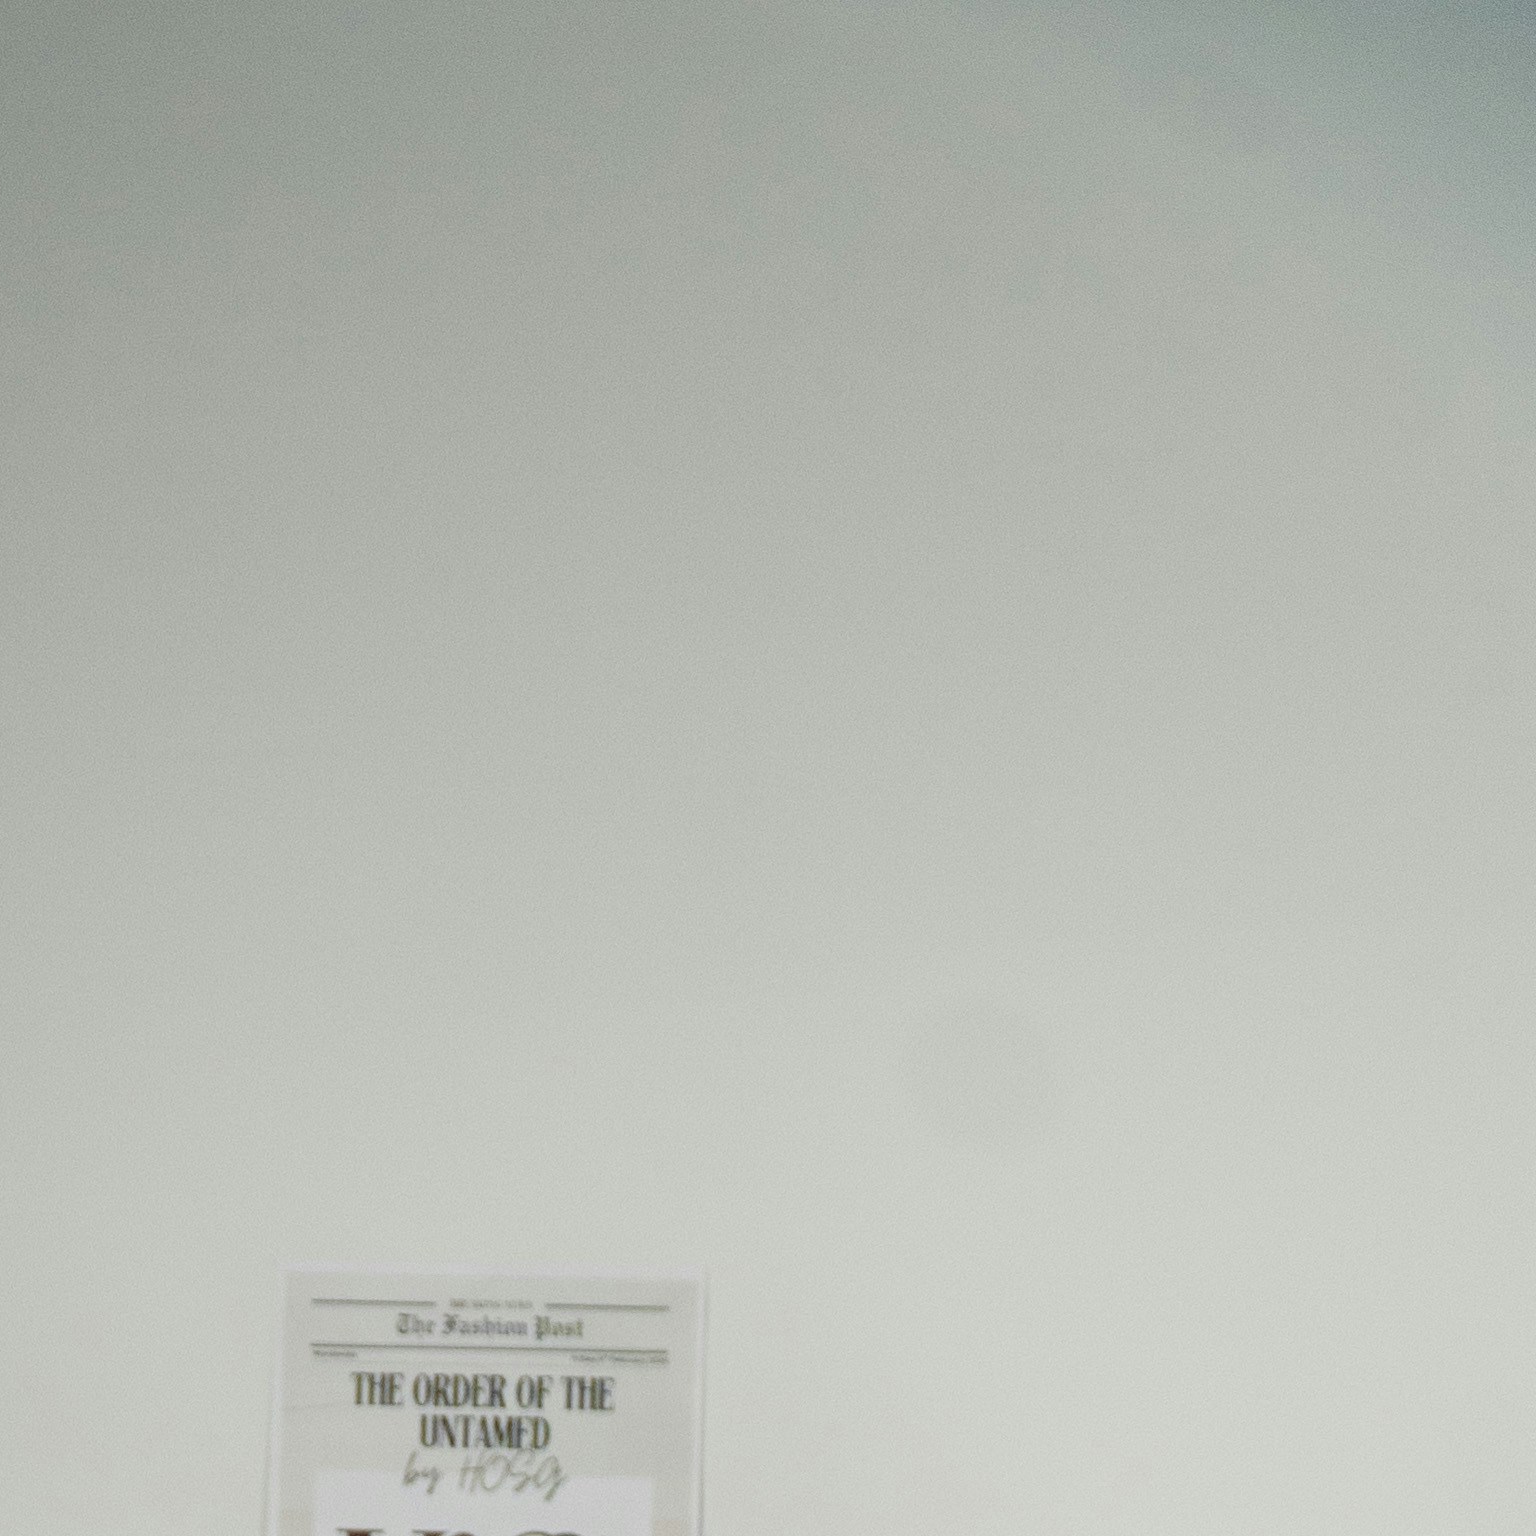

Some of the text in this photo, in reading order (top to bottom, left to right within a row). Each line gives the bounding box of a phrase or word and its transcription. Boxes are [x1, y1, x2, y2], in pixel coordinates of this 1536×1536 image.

[351, 1371, 615, 1411] THE ORDER OF THE
[419, 1414, 551, 1450] UNTAMED
